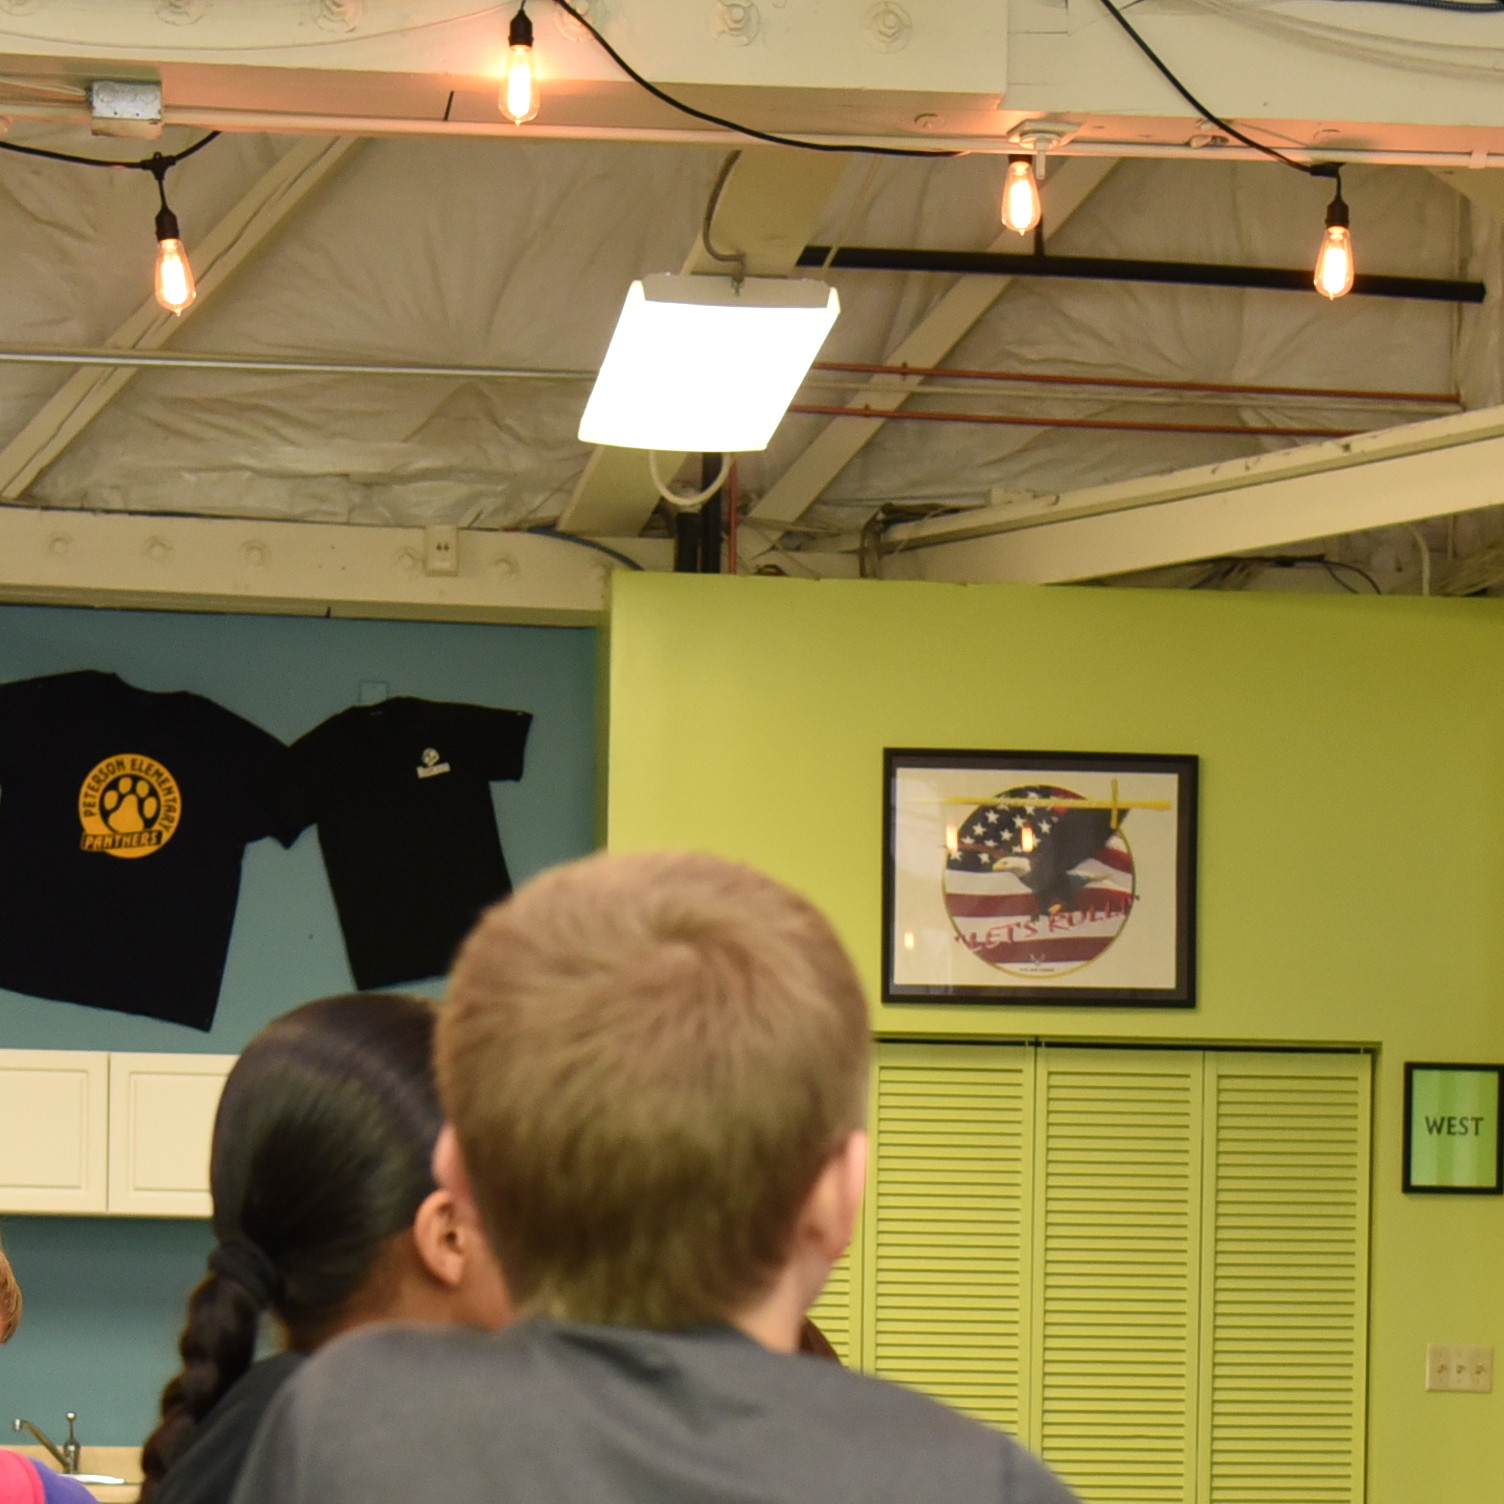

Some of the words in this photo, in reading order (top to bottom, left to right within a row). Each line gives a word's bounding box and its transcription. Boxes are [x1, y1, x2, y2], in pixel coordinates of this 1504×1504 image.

[83, 759, 125, 818] PETERSON
[130, 758, 177, 832] ELEMENTARY
[84, 831, 158, 850] PANTHERS
[1425, 1116, 1484, 1136] WEST
